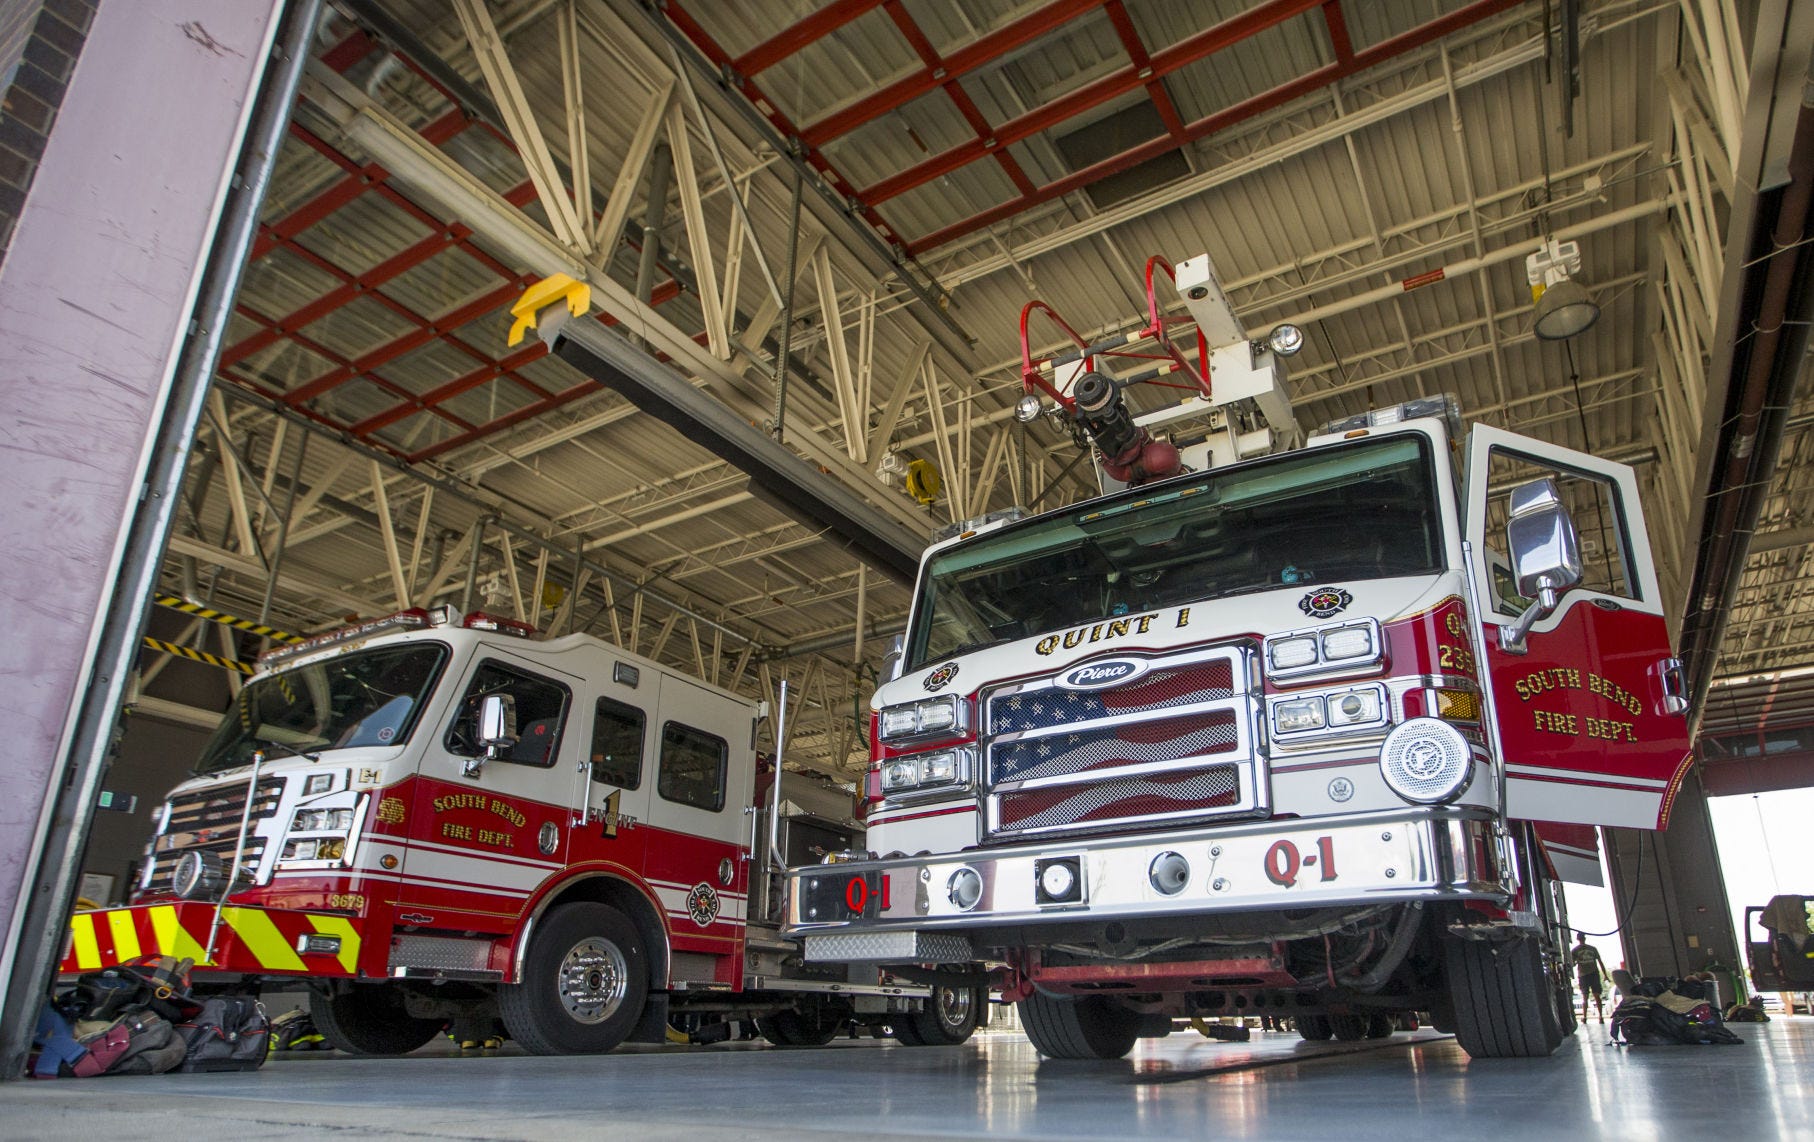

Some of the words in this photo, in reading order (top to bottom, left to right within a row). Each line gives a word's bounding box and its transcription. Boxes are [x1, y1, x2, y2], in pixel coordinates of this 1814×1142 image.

[1035, 613, 1159, 656] QUINT
[1074, 665, 1128, 684] Pierce
[1515, 668, 1582, 701] SOUTH
[1588, 673, 1642, 716] BEND
[1533, 710, 1579, 735] FIRE
[1586, 717, 1638, 743] DEPT.
[433, 794, 487, 813] SOUTH
[490, 799, 527, 828] BEND
[588, 807, 637, 830] ENGINE
[601, 789, 621, 839] 1
[442, 823, 473, 841] FIRE
[478, 829, 514, 848] DEPT.
[331, 894, 364, 908] 3679
